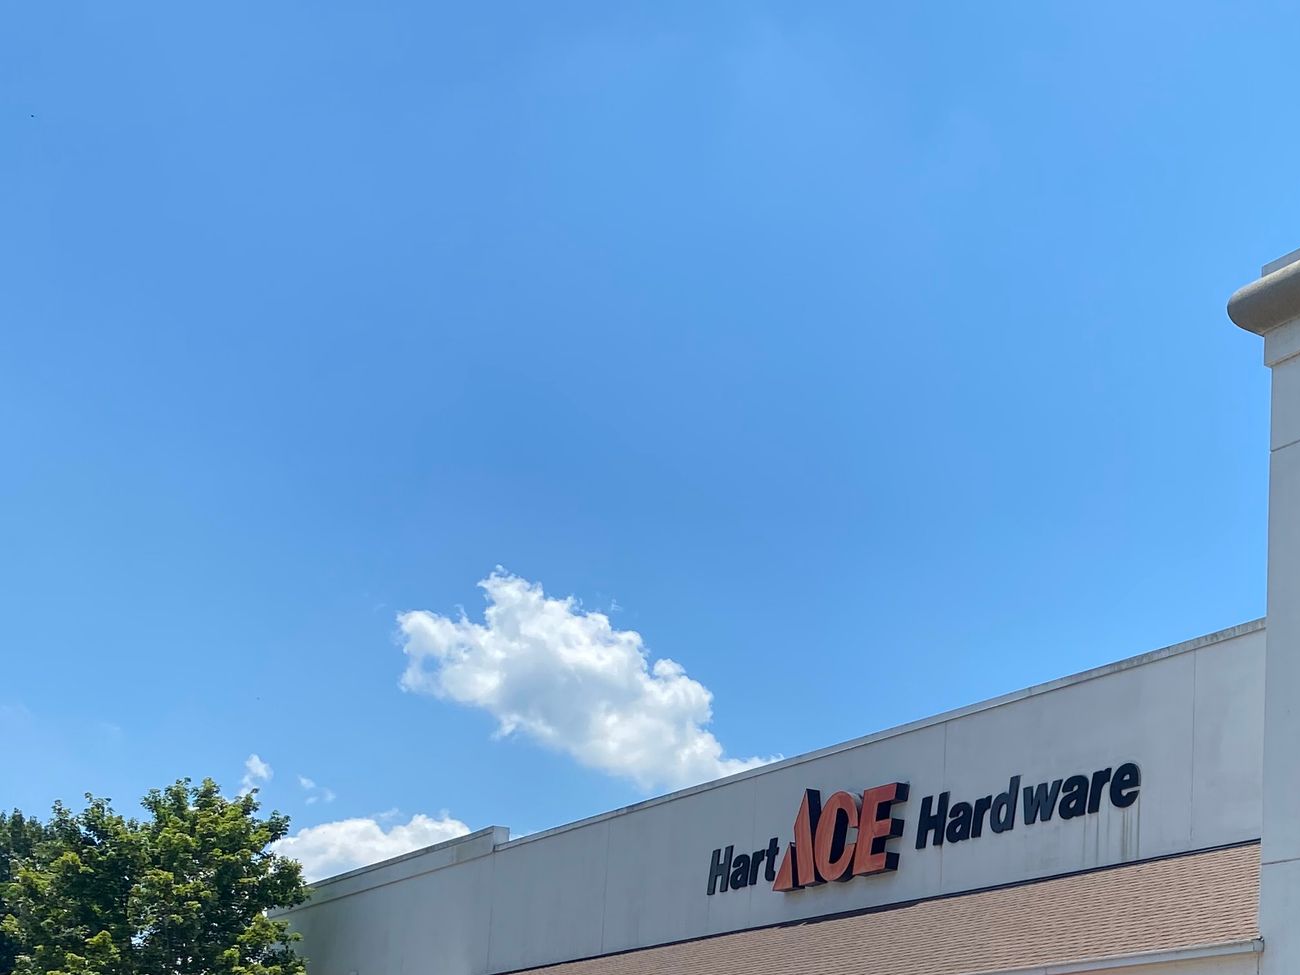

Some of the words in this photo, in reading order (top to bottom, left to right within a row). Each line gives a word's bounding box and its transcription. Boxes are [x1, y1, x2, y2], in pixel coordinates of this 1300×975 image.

[706, 836, 779, 896] Hart
[772, 780, 910, 893] ACE
[915, 761, 1142, 851] Hardware
